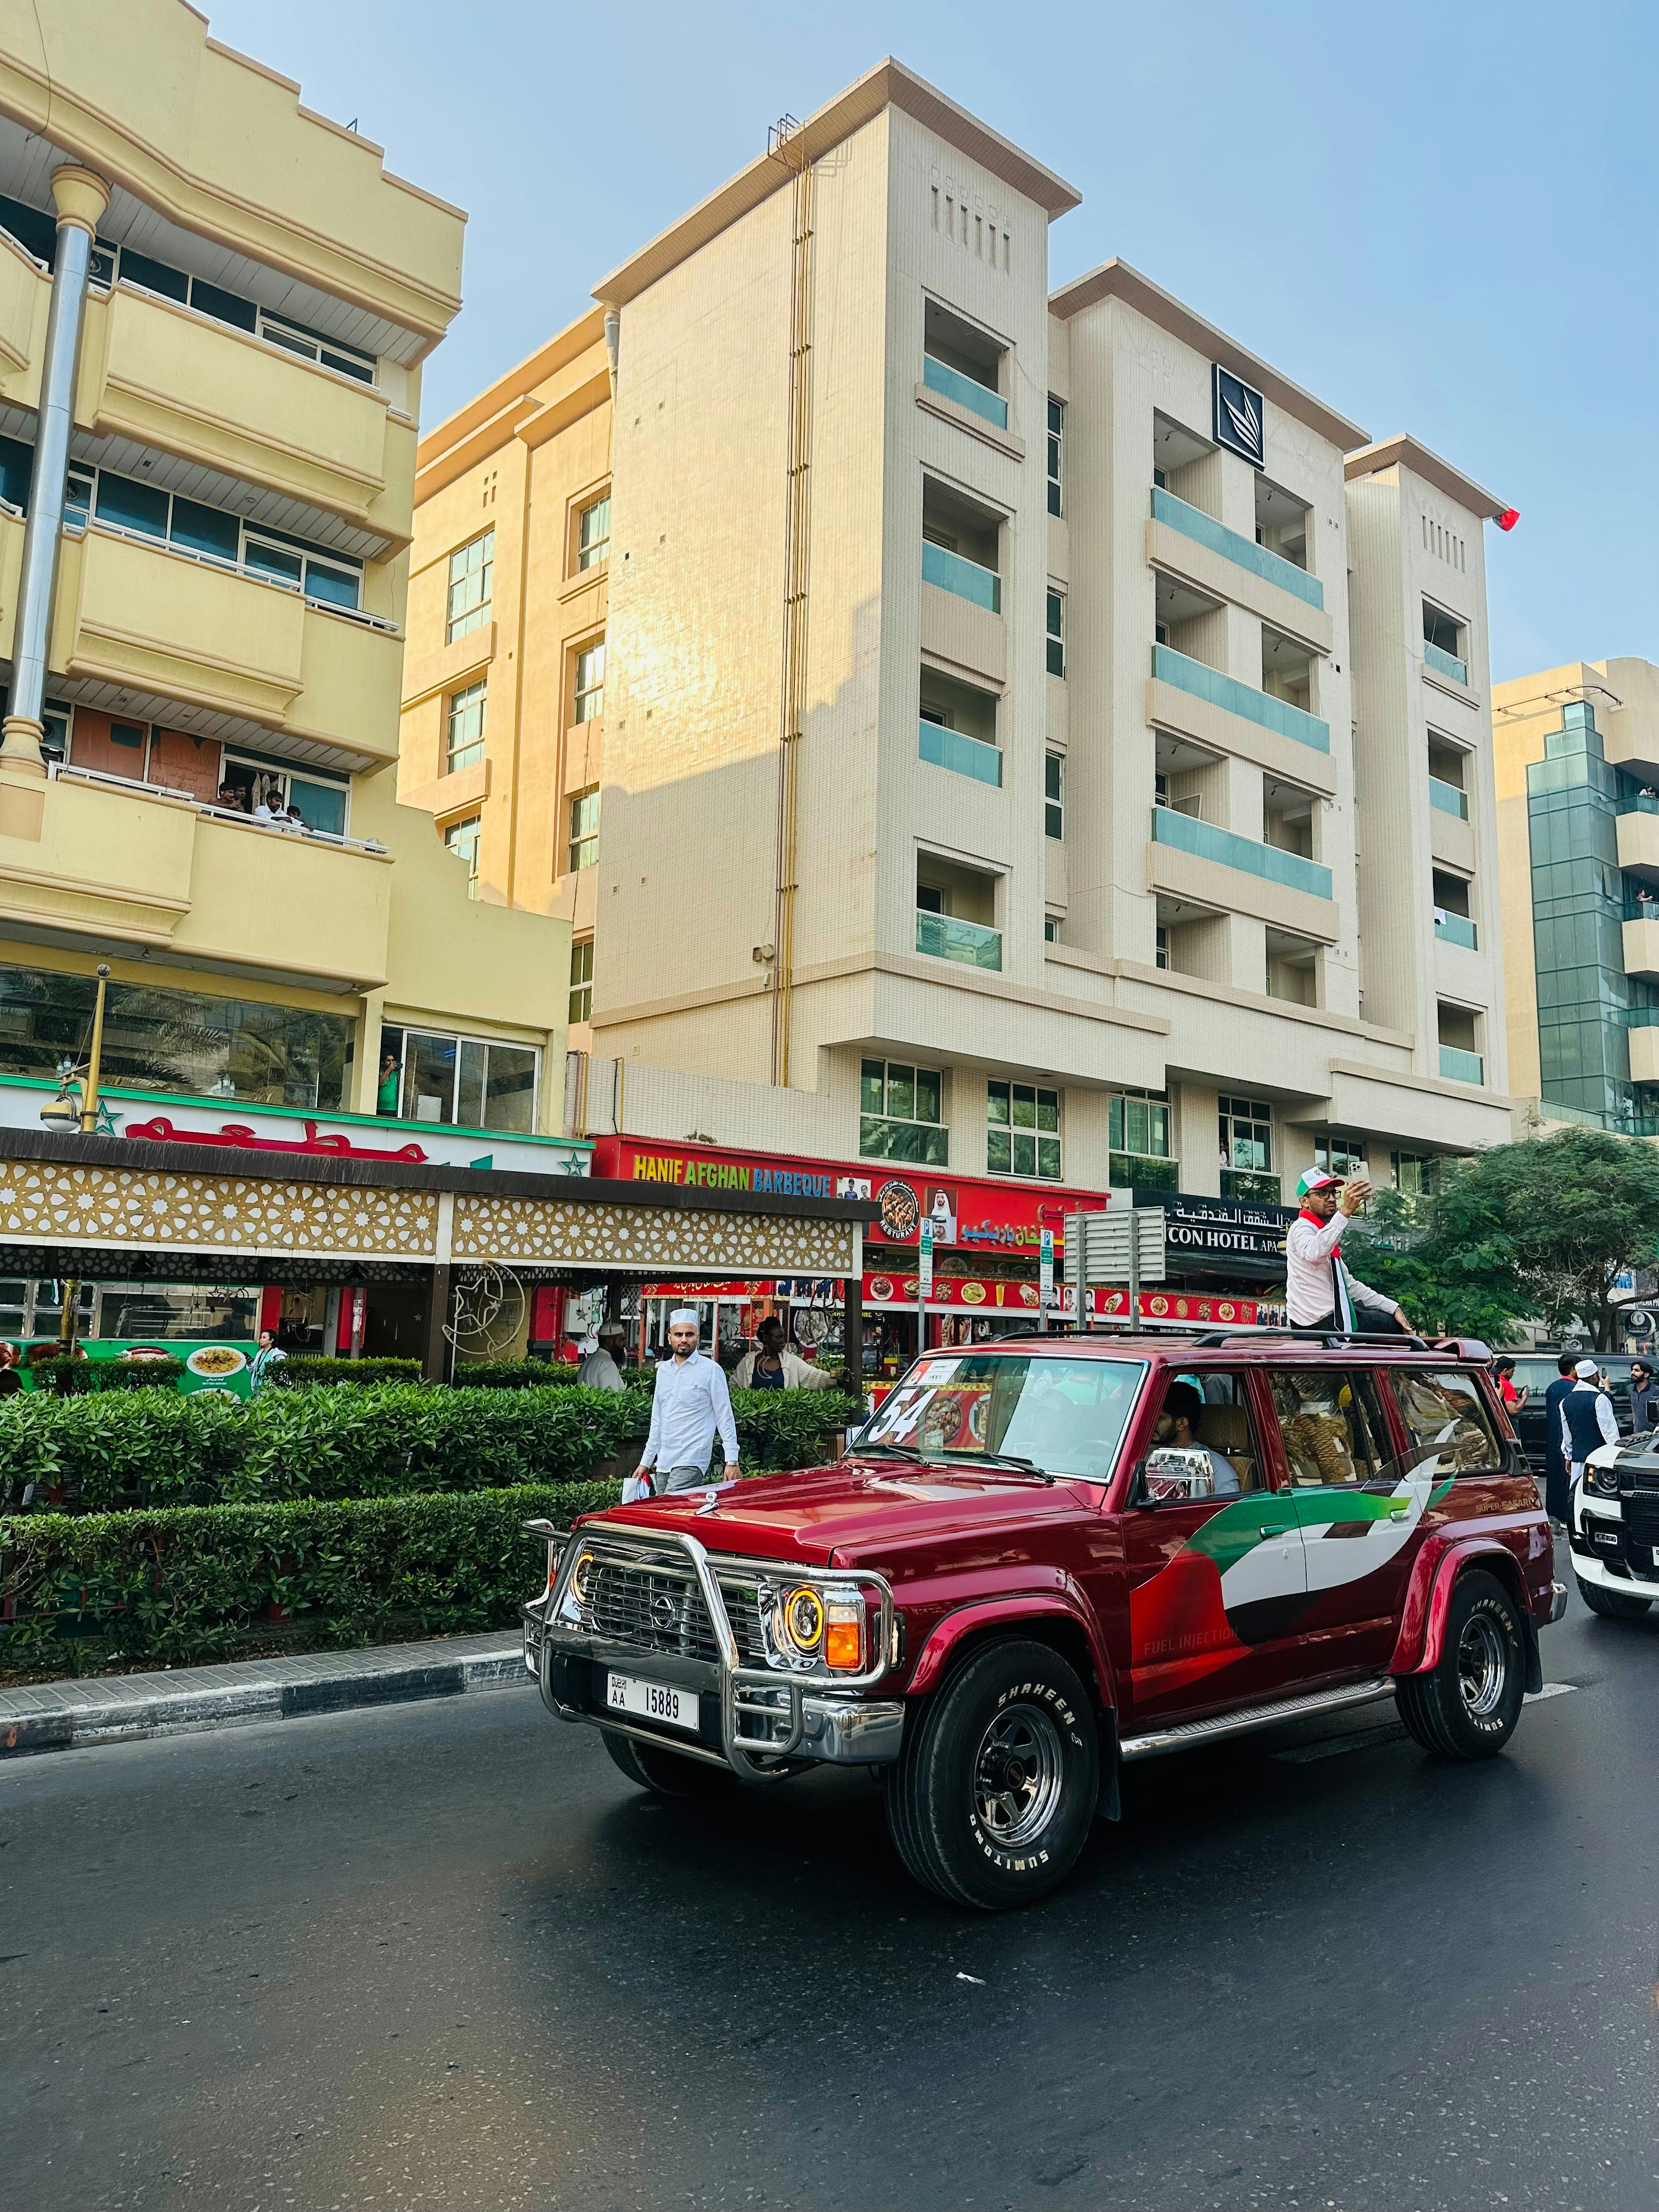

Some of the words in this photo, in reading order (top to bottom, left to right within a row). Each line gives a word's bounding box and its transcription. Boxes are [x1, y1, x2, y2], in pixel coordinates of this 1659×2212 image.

[634, 1155, 682, 1183] HANIF
[684, 1161, 749, 1190] AFGHAN
[752, 1168, 831, 1198] BARBEQUE
[1176, 1201, 1242, 1224] الفندقية
[879, 1220, 916, 1239] RESTURANT
[1207, 1231, 1258, 1251] HOTEL
[867, 1389, 938, 1443] 54
[1476, 1502, 1500, 1513] SUPER
[1471, 1599, 1514, 1632] SHAHEEN
[1144, 1638, 1175, 1655] FUEL
[1180, 1627, 1238, 1649] INJECTION
[612, 1690, 625, 1707] AA
[646, 1686, 679, 1719] 15889
[998, 1683, 1076, 1725] SHAHEEN
[969, 1813, 1049, 1871] SUMITOMO
